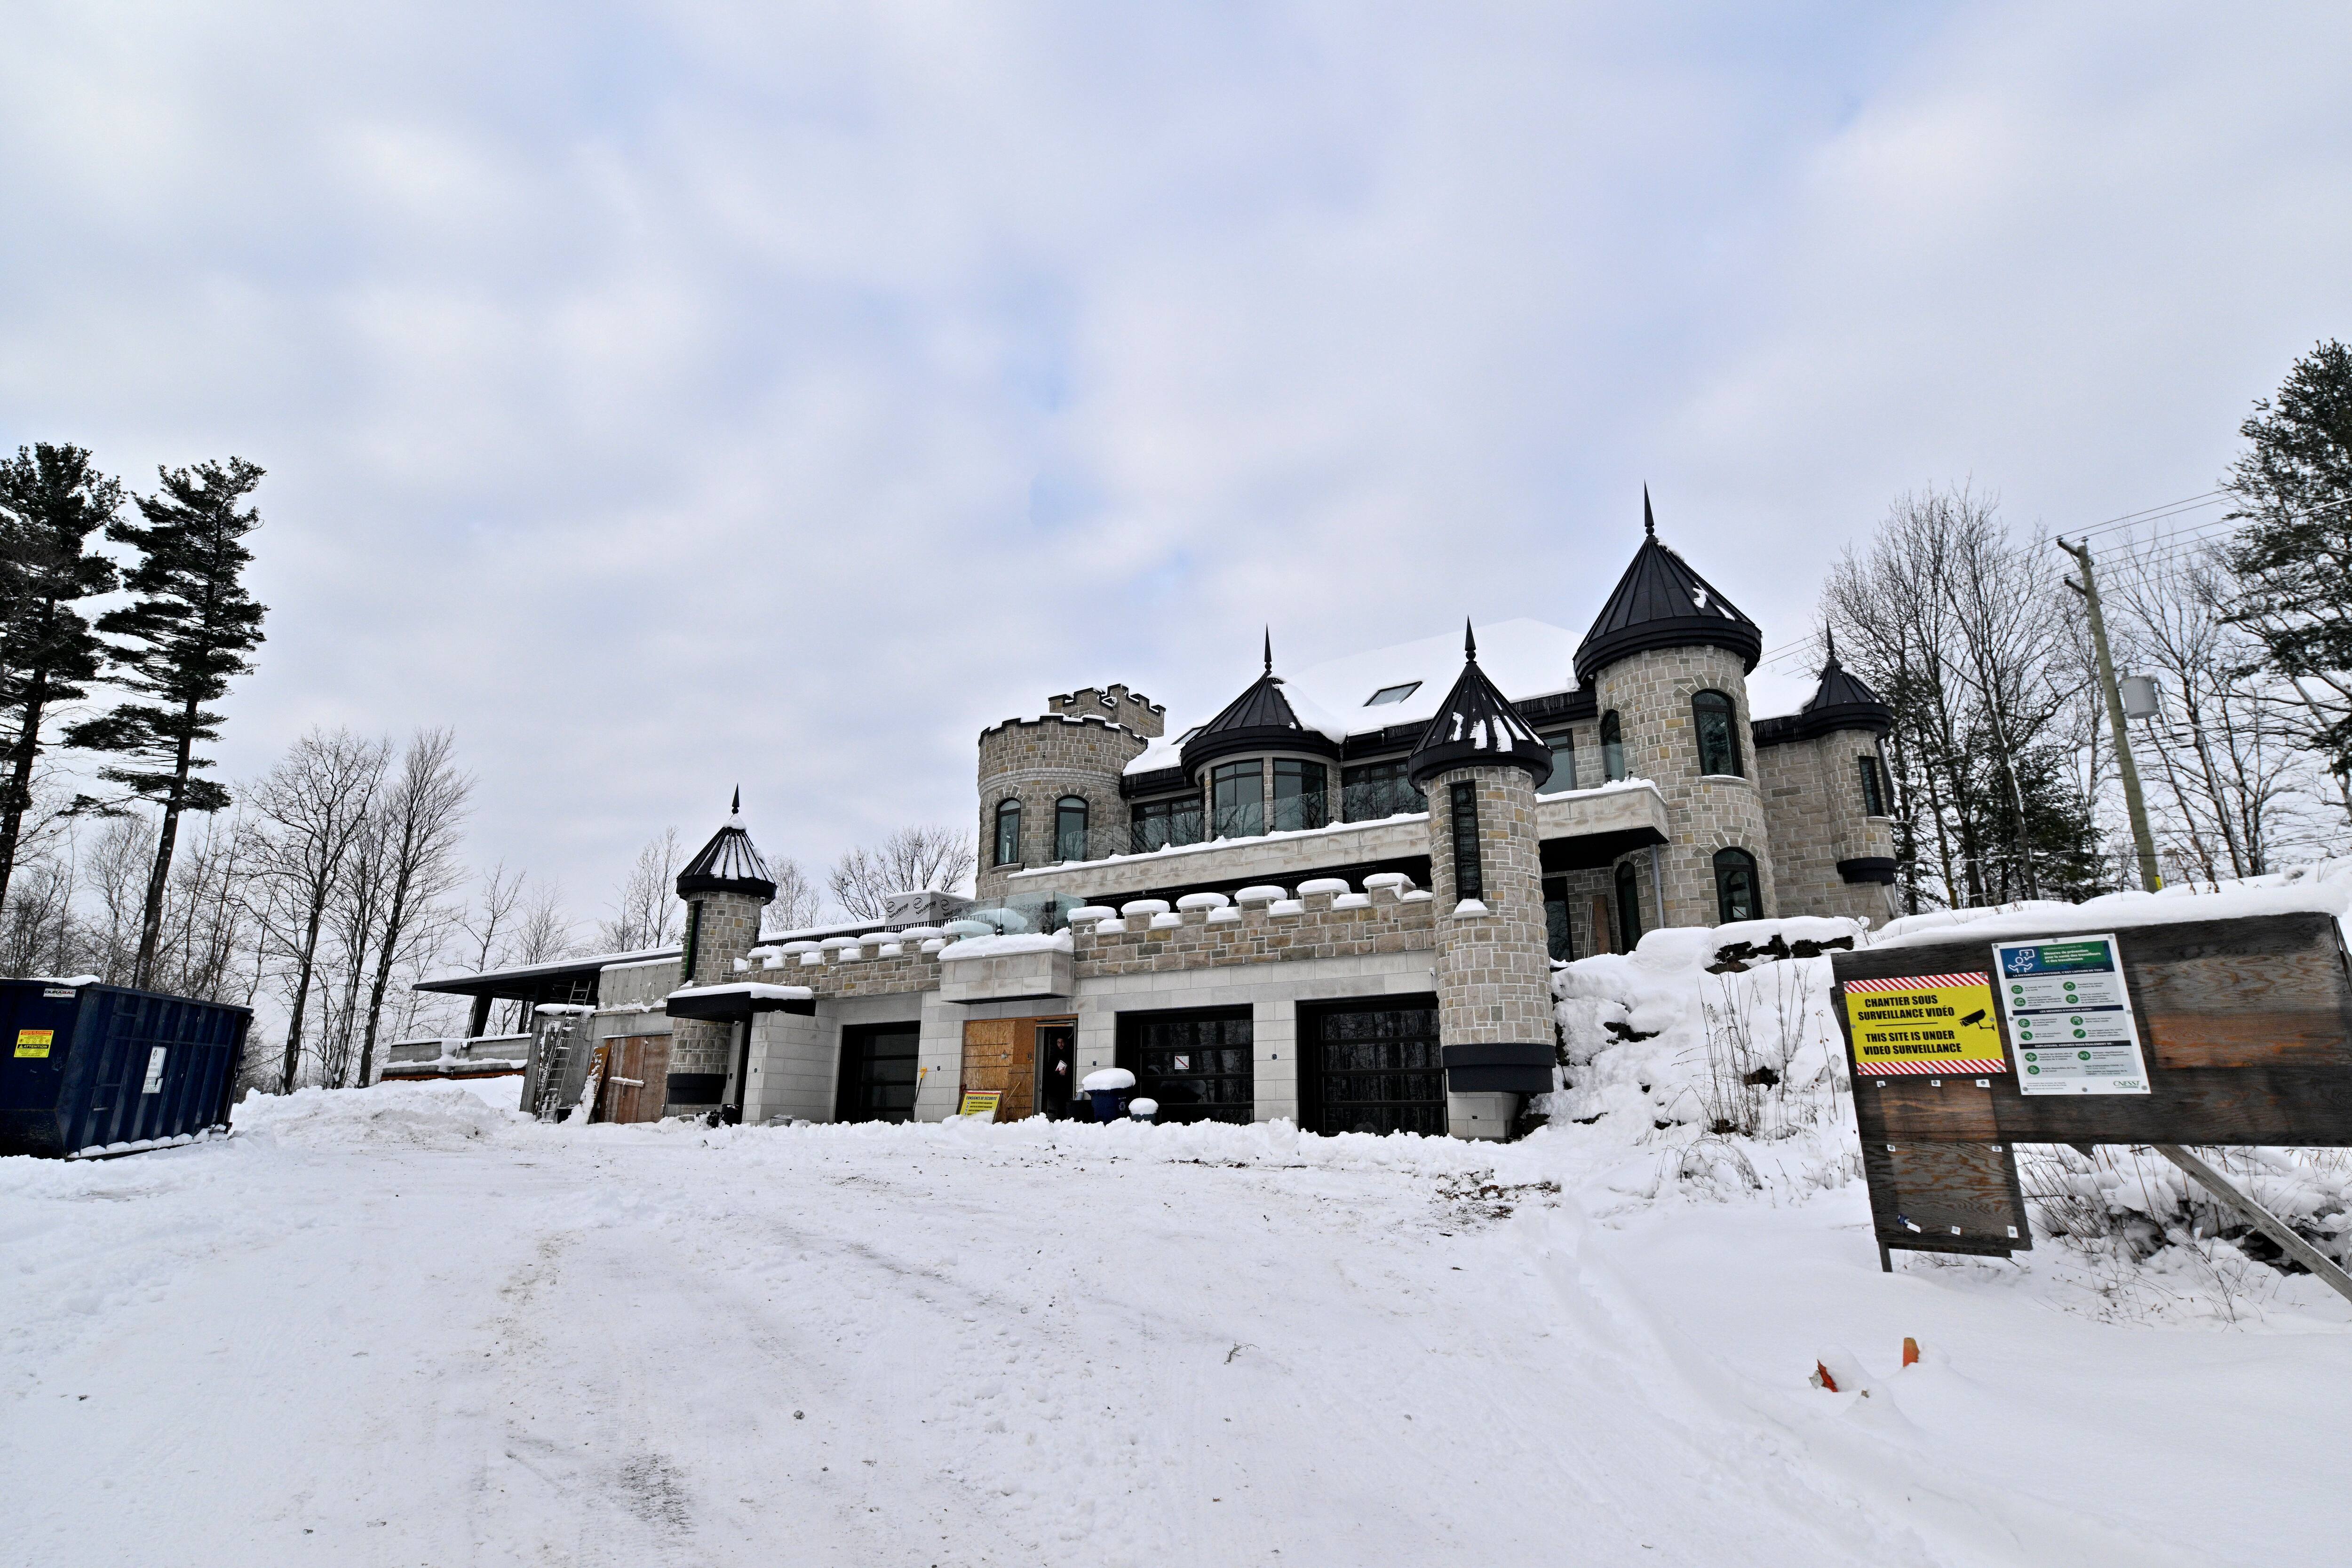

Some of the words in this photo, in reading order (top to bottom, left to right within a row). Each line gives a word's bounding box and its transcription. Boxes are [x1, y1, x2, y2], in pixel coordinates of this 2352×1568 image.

[889, 903, 908, 919] NovaWrap
[915, 901, 937, 915] NovaWrap
[943, 907, 962, 917] NovaWrap
[1865, 996, 1910, 1008] CHANTIER
[1912, 995, 1938, 1005] SOUS
[1858, 1008, 1924, 1020] SURVEILLANCE
[1925, 1005, 1955, 1017] VIDÉO
[1865, 1033, 1887, 1042] THIS
[1889, 1032, 1909, 1041] SITE
[1910, 1032, 1921, 1041] IS
[1923, 1030, 1955, 1040] UNDER
[1863, 1045, 1891, 1055] VIDEO
[1893, 1043, 1962, 1054] SURVEILLANCE
